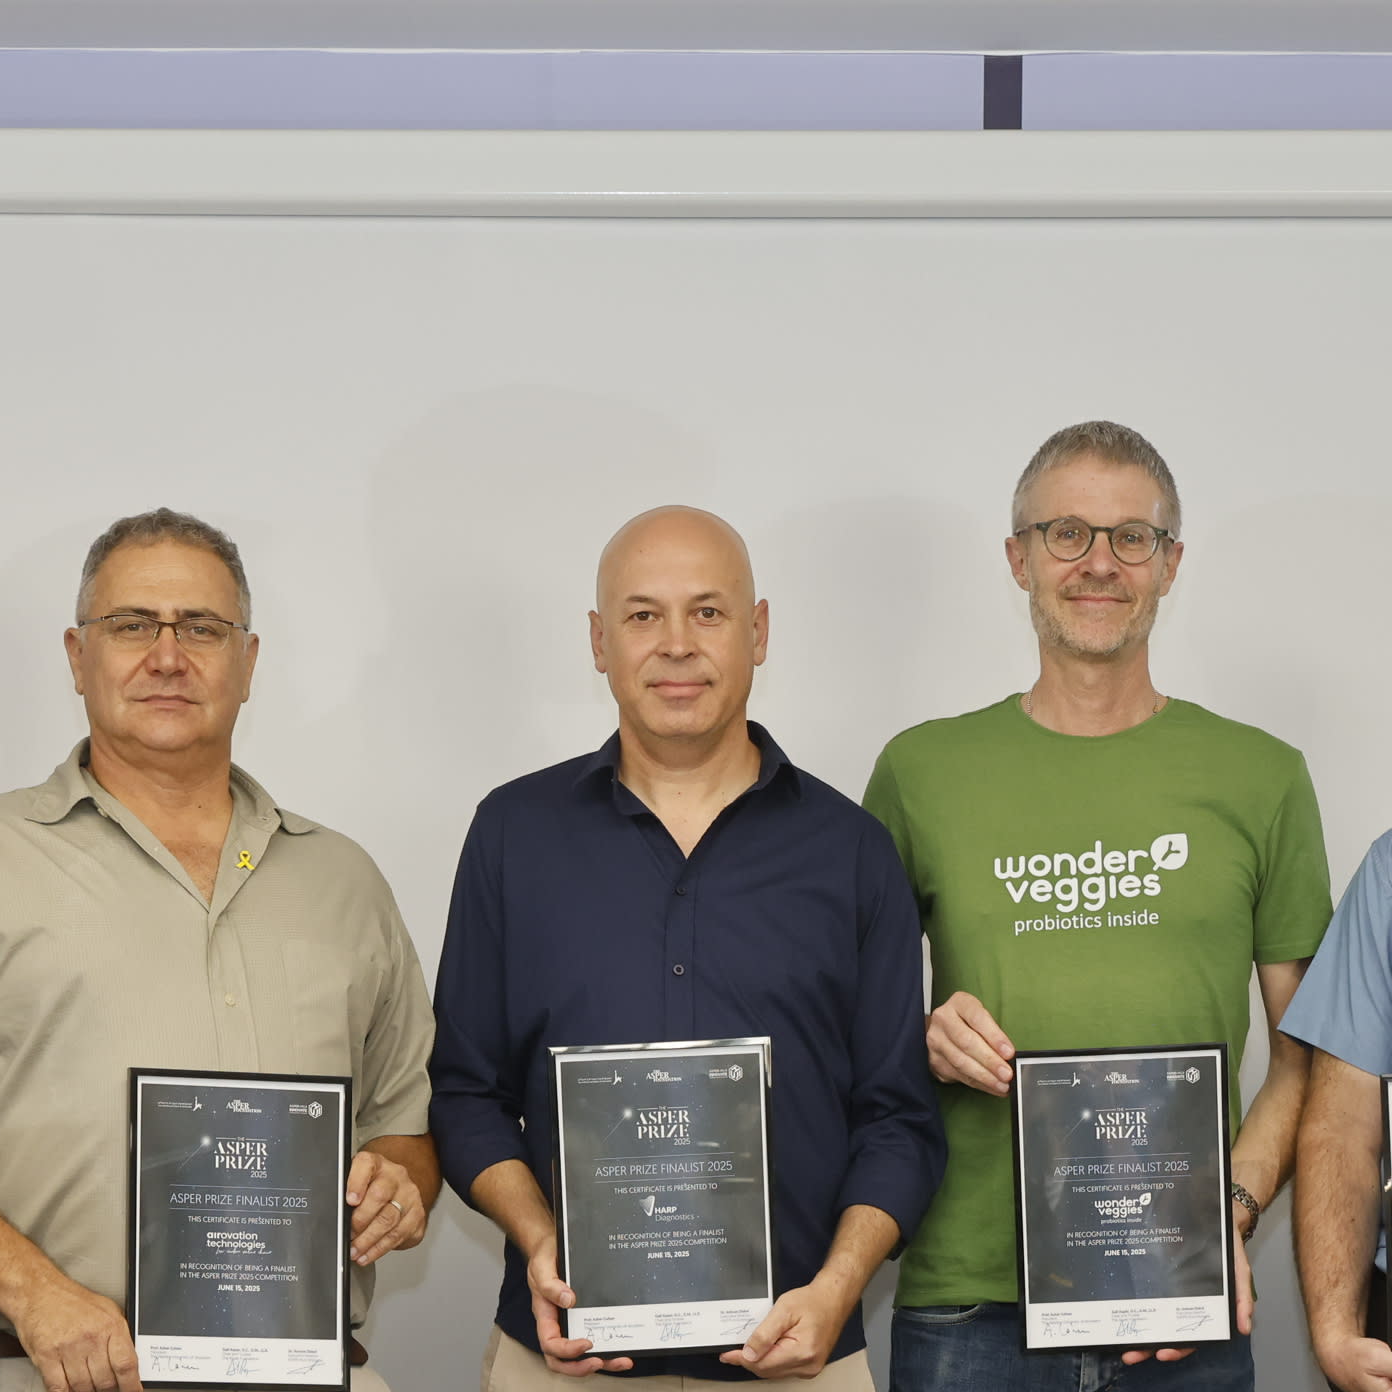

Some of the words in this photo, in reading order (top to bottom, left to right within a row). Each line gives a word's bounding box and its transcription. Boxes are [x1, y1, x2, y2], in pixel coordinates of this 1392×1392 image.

[994, 840, 1148, 879] wonder
[1006, 873, 1161, 912] veggies
[1014, 914, 1102, 936] probiotics
[1108, 910, 1159, 927] inside
[636, 1110, 691, 1125] ASPER
[1094, 1112, 1149, 1126] ASPER
[638, 1124, 689, 1139] PRIZE
[1096, 1125, 1147, 1140] PRIZE
[214, 1141, 268, 1156] ASPER
[674, 1138, 690, 1146] 2025
[1131, 1138, 1148, 1146] 2025
[215, 1155, 267, 1170] PRIZE
[595, 1166, 626, 1177] ASPER
[630, 1164, 658, 1175] PRIZE
[660, 1162, 704, 1174] FINALIST
[707, 1160, 733, 1171] 2025
[1054, 1165, 1085, 1177] ASPER
[1088, 1163, 1115, 1174] PRIZE
[1118, 1162, 1162, 1173] FINALIST
[1164, 1160, 1189, 1172] 2025
[250, 1170, 267, 1178] 2025
[1087, 1184, 1123, 1192] CERTIFICATE
[1131, 1182, 1164, 1191] PRESENTED
[170, 1193, 202, 1204] ASPER
[205, 1194, 233, 1205] PRIZE
[236, 1195, 280, 1206] FINALIST
[282, 1197, 308, 1208] 2025
[1094, 1197, 1139, 1208] wonder
[655, 1206, 677, 1214] HARP
[1098, 1206, 1143, 1217] veggies
[203, 1216, 240, 1224] CERTIFICATE
[248, 1217, 281, 1225] PRESENTED
[655, 1214, 695, 1222] Diagnostics
[207, 1231, 258, 1240] airovation
[207, 1239, 266, 1250] technologies
